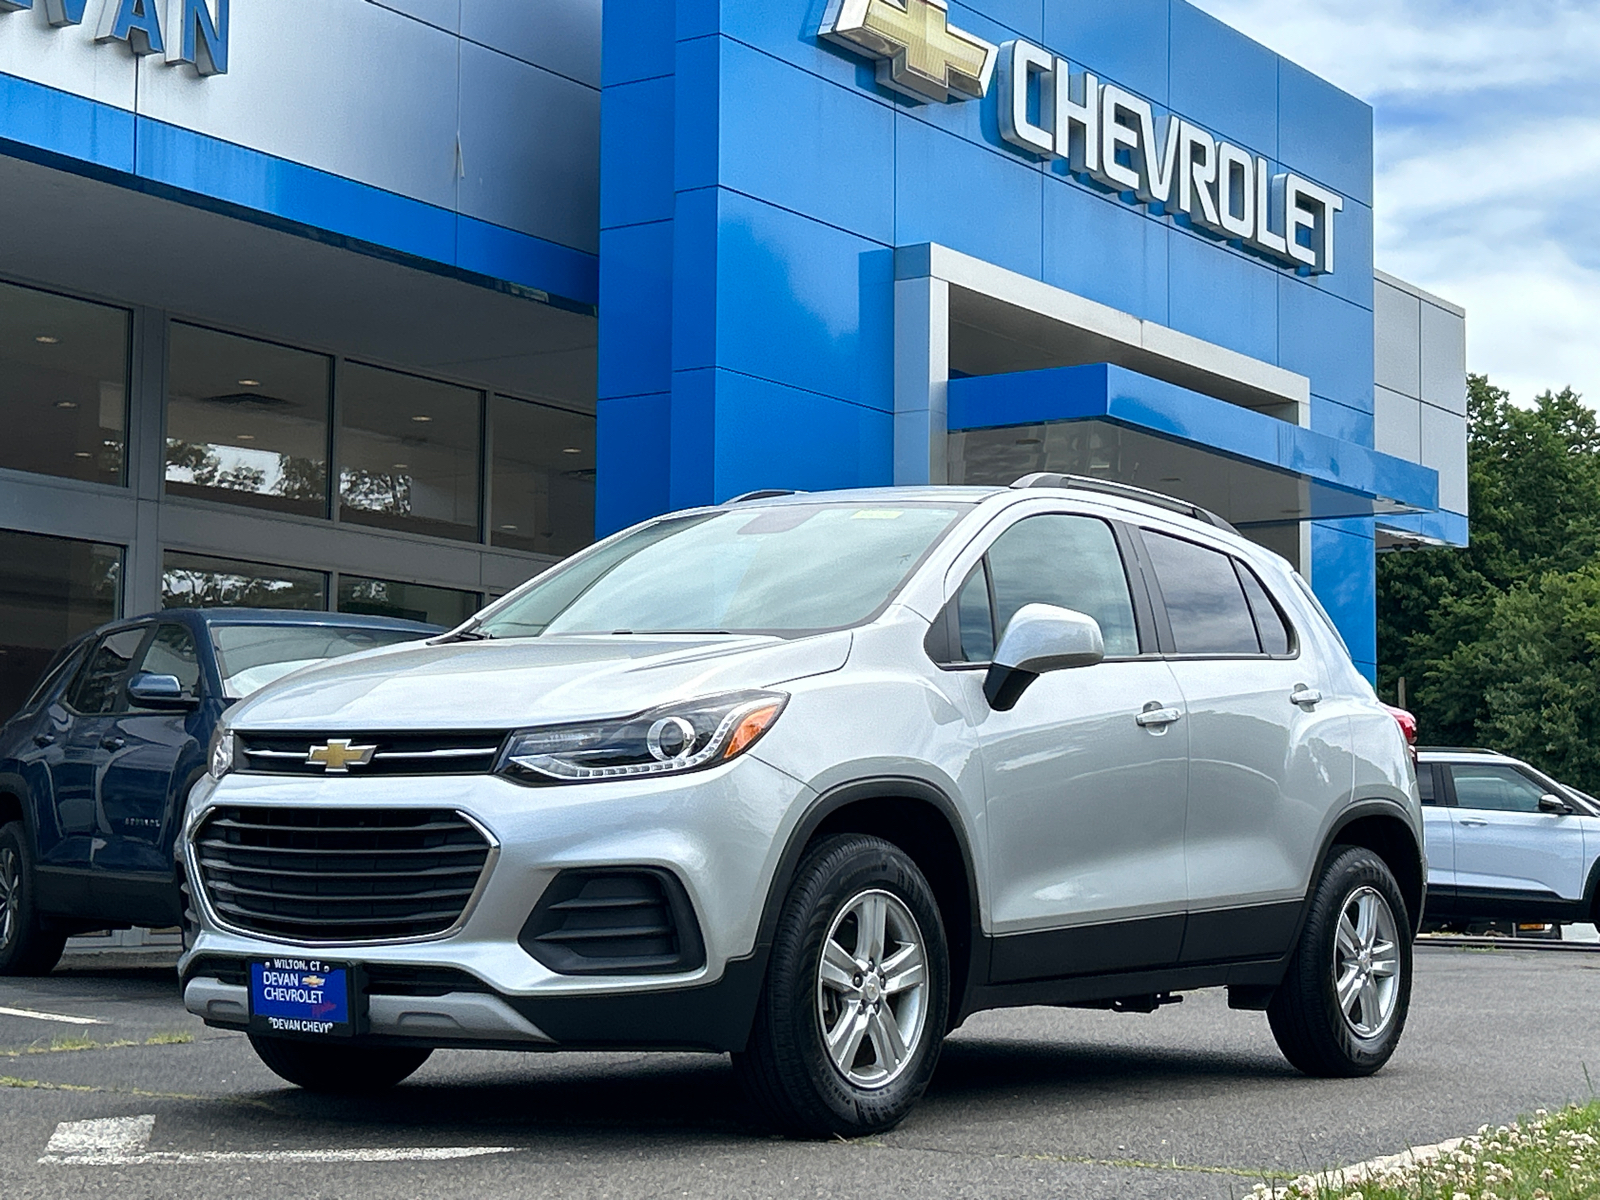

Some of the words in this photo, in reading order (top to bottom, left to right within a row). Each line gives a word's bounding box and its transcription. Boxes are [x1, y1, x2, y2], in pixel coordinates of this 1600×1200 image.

[1008, 38, 1344, 275] CHEVROLET
[310, 961, 321, 971] CT
[263, 972, 299, 987] DEVAN
[264, 987, 324, 1004] CHEVROLET
